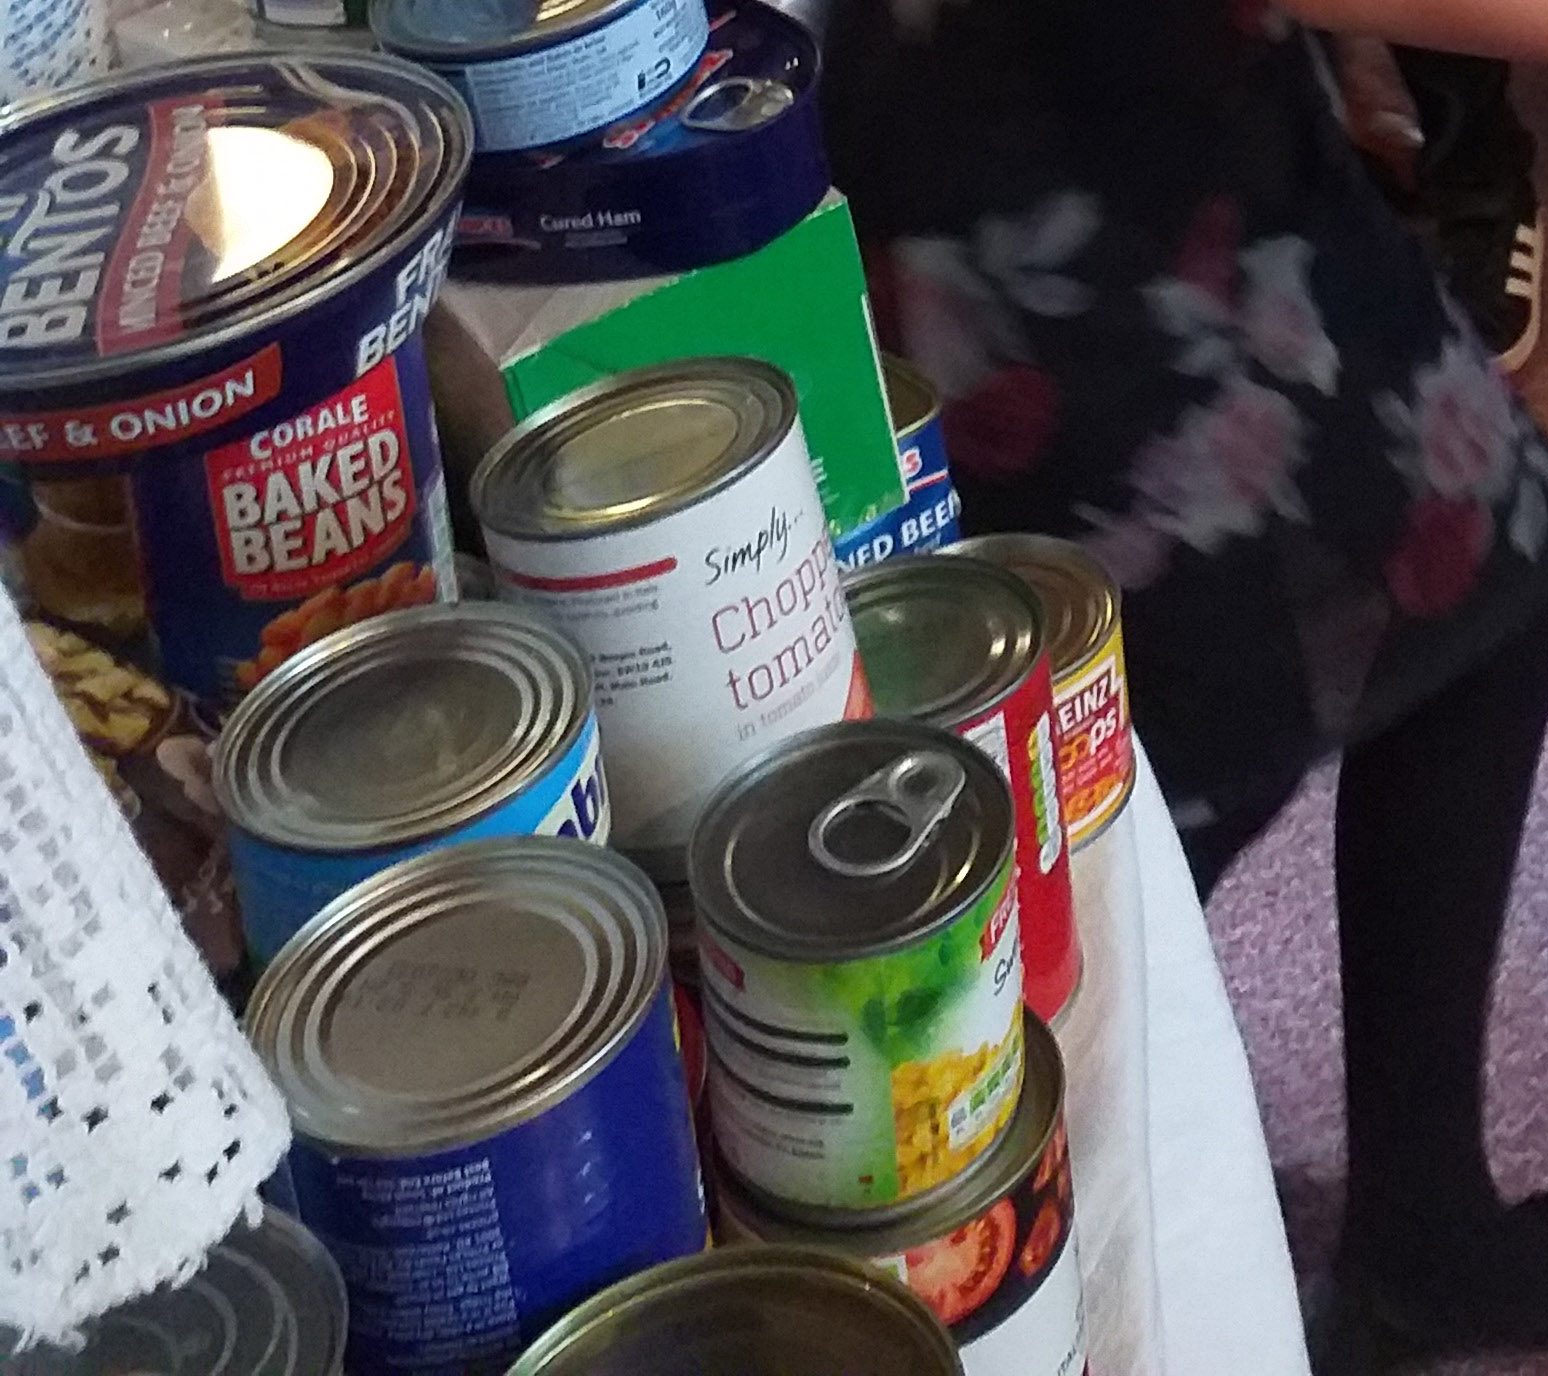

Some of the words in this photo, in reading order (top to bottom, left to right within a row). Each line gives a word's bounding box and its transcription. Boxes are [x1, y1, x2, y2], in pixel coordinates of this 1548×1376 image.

[0, 125, 140, 346] BENTOS
[540, 213, 594, 233] Cured
[599, 209, 642, 228] Ham
[110, 369, 255, 441] ONION
[250, 394, 370, 460] CORALE
[223, 428, 399, 529] BAKED
[231, 468, 407, 575] BEANS
[1056, 676, 1110, 734] EINZ
